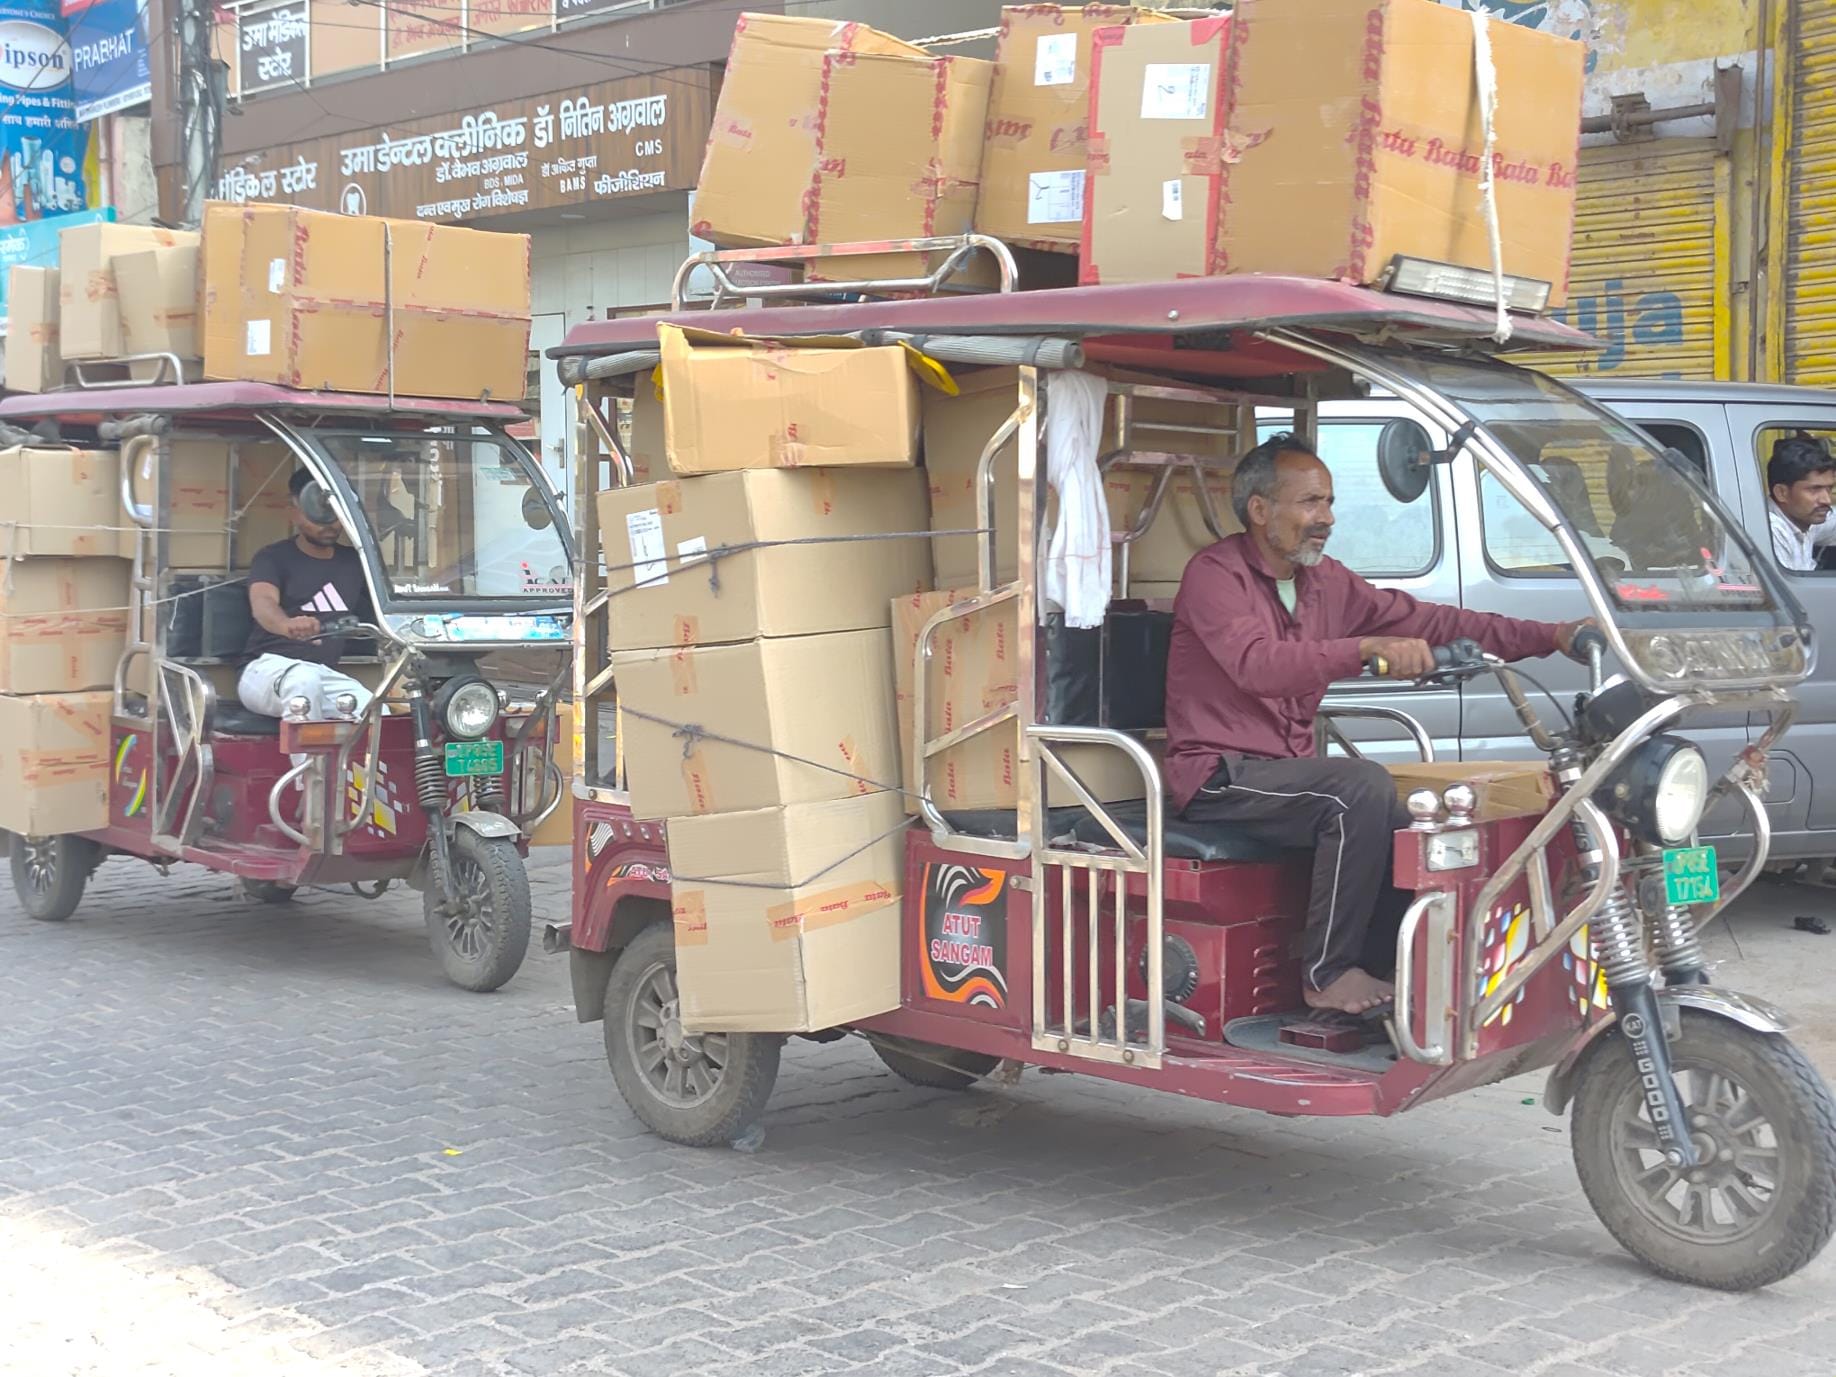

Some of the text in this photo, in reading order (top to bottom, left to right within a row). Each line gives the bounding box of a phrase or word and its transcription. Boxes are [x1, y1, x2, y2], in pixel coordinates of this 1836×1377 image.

[0, 43, 64, 69] ipson
[74, 27, 135, 72] PRABHAT
[533, 94, 667, 148] डॉ नितिन अग्रवाल
[340, 145, 375, 176] उमा
[433, 111, 527, 159] क्लीनिक
[636, 139, 663, 157] CMS
[1424, 137, 1480, 174] Bata
[280, 155, 318, 194] स्टोर
[560, 176, 586, 193] BAMS
[942, 912, 981, 939] ATUT
[931, 938, 993, 968] SANGAM
